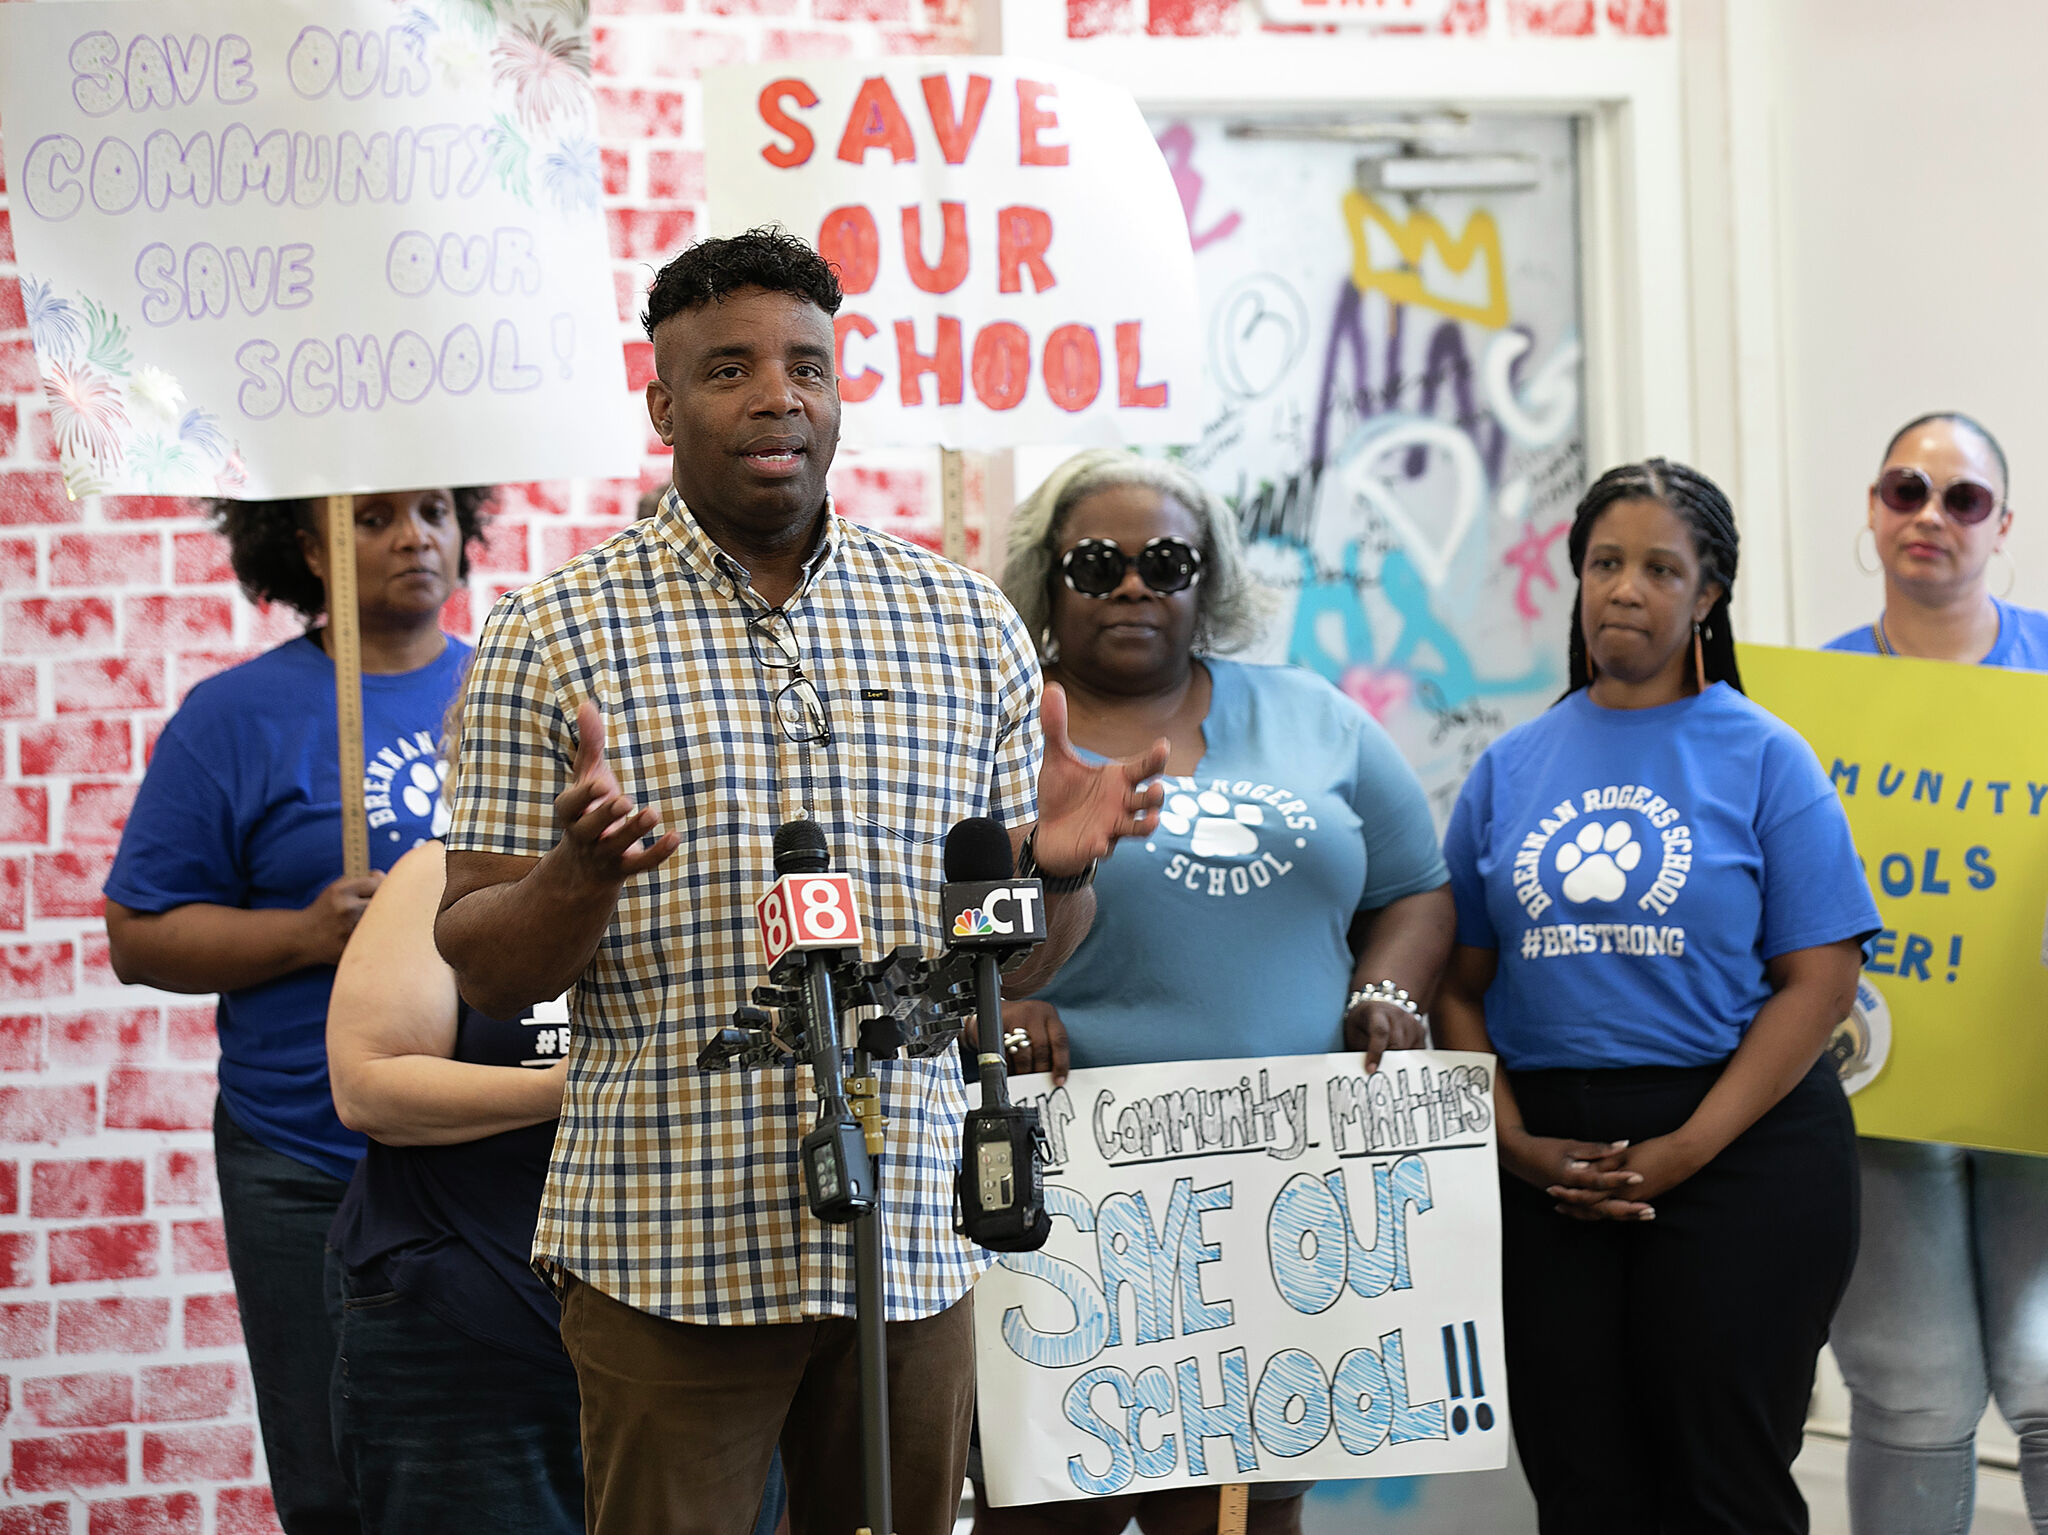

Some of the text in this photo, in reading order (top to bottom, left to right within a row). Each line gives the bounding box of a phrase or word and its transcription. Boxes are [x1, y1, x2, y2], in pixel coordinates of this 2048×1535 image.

[69, 25, 430, 118] SAVE OUR
[757, 73, 1071, 169] SAVE
[22, 122, 505, 222] COMMUNITY
[135, 226, 542, 328] SAVE OUR
[818, 200, 1057, 295] OUR
[235, 311, 577, 421] SCHOOL!
[832, 312, 1169, 413] CHOOL
[362, 730, 437, 830] BRENNAN
[1210, 778, 1318, 832] ROGERS
[1829, 757, 2048, 817] MUNITY
[1164, 851, 1294, 898] SCHOOL
[1512, 784, 1694, 922] BRENNAN ROGERS SCHOOL
[1879, 845, 1997, 898] OLS
[762, 894, 788, 958] 8
[799, 878, 848, 940] 8
[981, 886, 1039, 935] CT
[1520, 922, 1686, 961] #BRSTRONG
[1000, 1176, 1236, 1368] SAVE
[1062, 1320, 1496, 1496] SCHOOL!!
